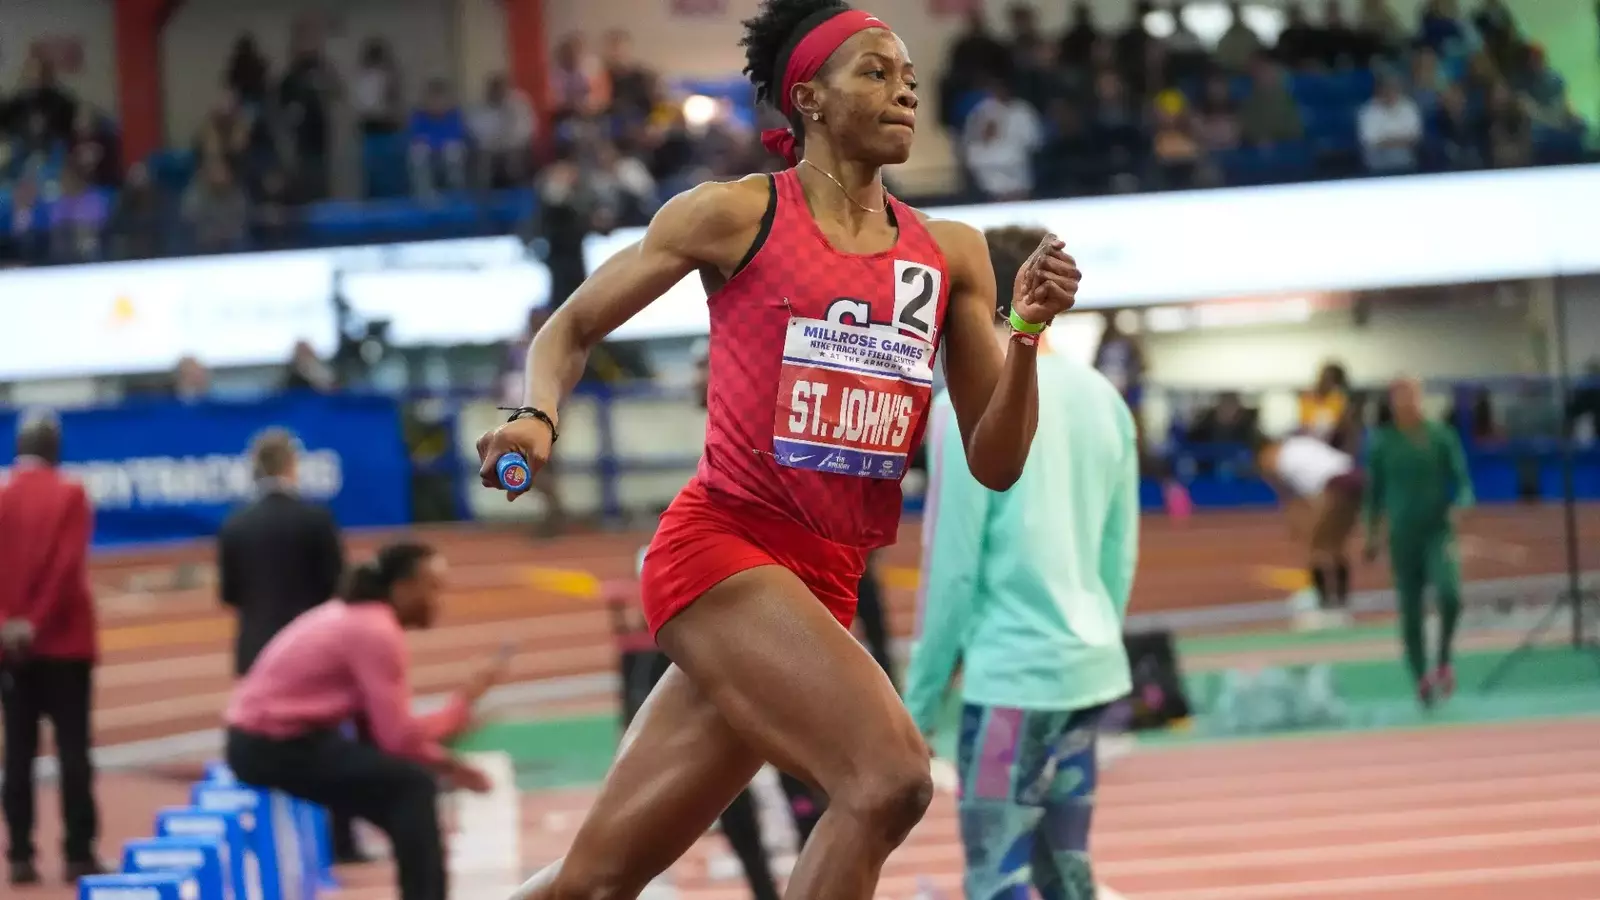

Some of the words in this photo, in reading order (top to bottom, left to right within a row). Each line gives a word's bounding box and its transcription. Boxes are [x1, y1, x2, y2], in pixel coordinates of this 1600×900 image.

[898, 266, 934, 335] 2
[803, 325, 878, 349] MILLROSE
[881, 339, 924, 360] GAMES
[810, 340, 831, 350] NIKE
[832, 343, 858, 356] TRACK
[859, 348, 866, 357] &
[867, 349, 892, 361] FIELD
[844, 355, 860, 364] THE
[863, 359, 903, 371] ARMORY
[788, 379, 828, 438] ST.
[832, 386, 913, 447] JOHN'S
